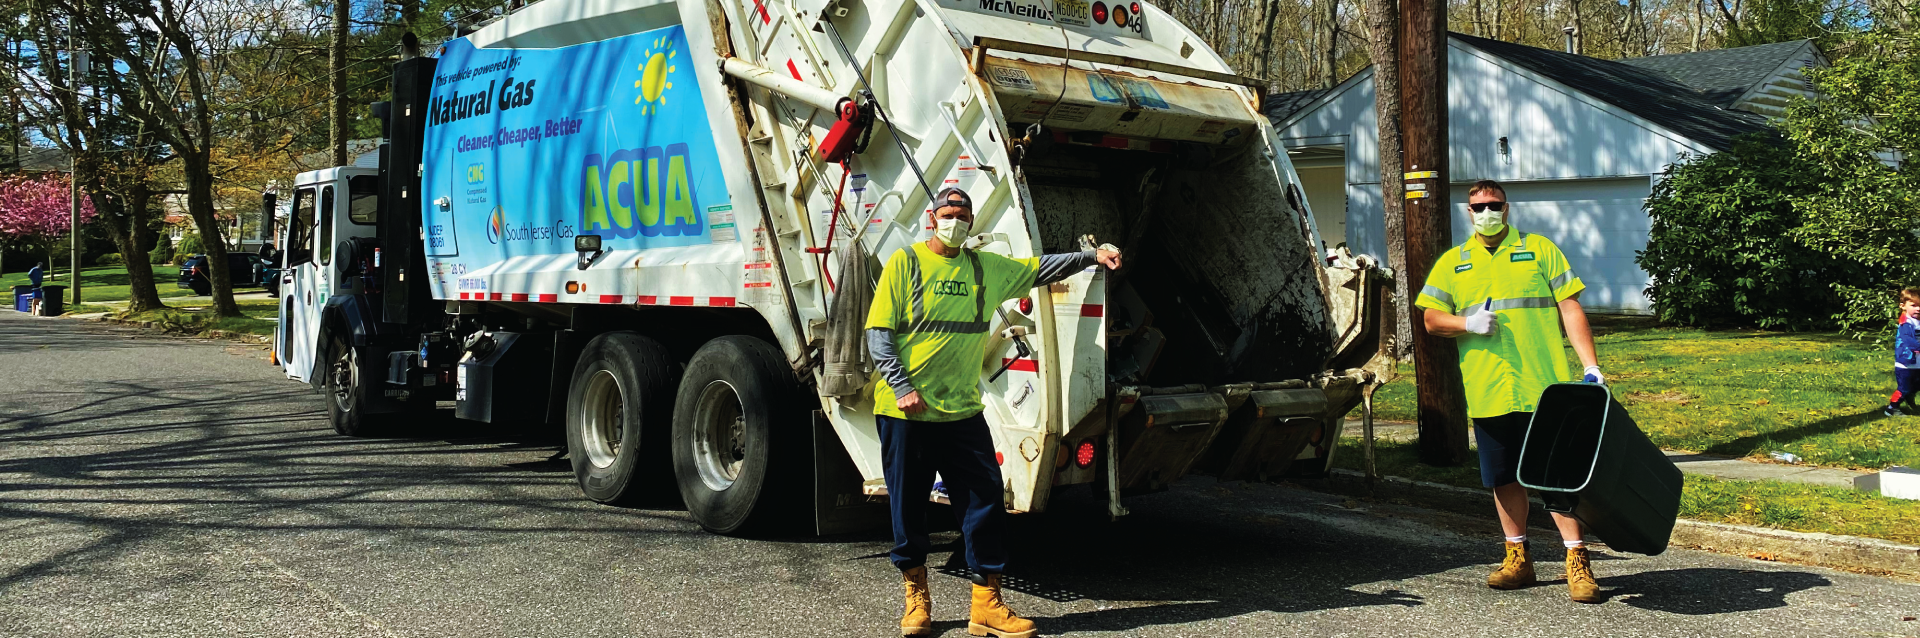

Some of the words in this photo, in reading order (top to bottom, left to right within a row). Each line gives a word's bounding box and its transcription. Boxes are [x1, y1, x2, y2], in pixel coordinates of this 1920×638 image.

[1128, 15, 1142, 33] 46
[435, 73, 447, 88] This
[448, 67, 472, 84] vehicle
[471, 57, 508, 81] powered
[508, 55, 522, 72] by:
[429, 79, 496, 128] Natural
[498, 77, 537, 111] Gas
[457, 134, 494, 153] Cleaner,
[497, 126, 542, 148] Cheaper,
[545, 116, 582, 138] Better
[466, 163, 484, 183] CNG
[581, 149, 699, 236] ACUA
[505, 222, 529, 241] South
[529, 222, 555, 245] Jersey
[556, 219, 574, 238] Gas
[1511, 253, 1534, 261] ACUA
[933, 280, 969, 297] ACUA
